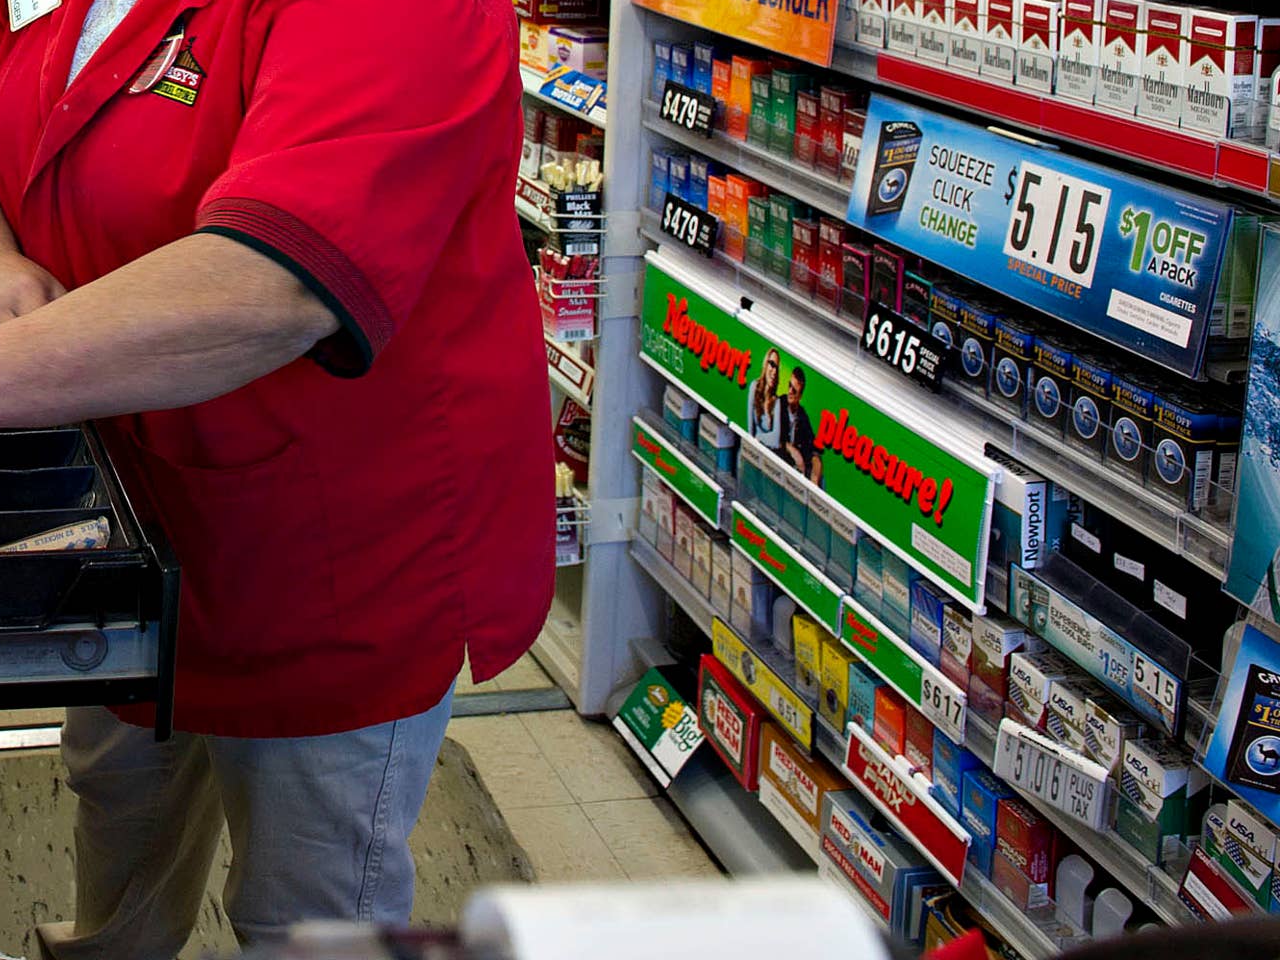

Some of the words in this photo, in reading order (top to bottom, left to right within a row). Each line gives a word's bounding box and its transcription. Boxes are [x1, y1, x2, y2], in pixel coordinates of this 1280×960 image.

[1061, 52, 1092, 78] Marlboro
[1101, 61, 1134, 88] Marlboro
[1143, 71, 1178, 100] Marlboro
[1187, 81, 1225, 111] Marlboro
[662, 89, 699, 129] $479
[928, 145, 995, 186] SQUEEZE
[566, 201, 591, 211] Black
[932, 178, 974, 213] CLICK
[663, 202, 699, 246] $479
[919, 206, 978, 247] CHANGE
[1004, 166, 1102, 276] $5.15
[1152, 221, 1206, 265] OFF
[1007, 258, 1048, 291] SPECIAL
[1050, 275, 1083, 300] PRICE
[1160, 291, 1197, 314] CIGARETTES
[663, 292, 752, 388] Newport
[866, 314, 921, 374] $6.15
[1176, 415, 1193, 429] OFF
[814, 408, 953, 526] pleasure!
[1024, 490, 1041, 563] Newport
[1050, 606, 1091, 641] EXPERIENCE
[1012, 665, 1032, 686] USA
[1110, 658, 1129, 678] OFF
[717, 699, 740, 736] RED
[1051, 693, 1074, 716] USA
[673, 712, 705, 753] Big!
[716, 718, 740, 754] MAN
[1085, 712, 1105, 734] USA
[775, 745, 793, 771] RED
[794, 767, 815, 795] MAN
[1126, 752, 1149, 777] USA
[863, 767, 903, 813] PRIX
[1070, 773, 1094, 800] PLUS
[1071, 795, 1090, 820] TAX
[831, 814, 851, 841] RED
[860, 846, 883, 878] MAN
[1230, 818, 1255, 844] USA
